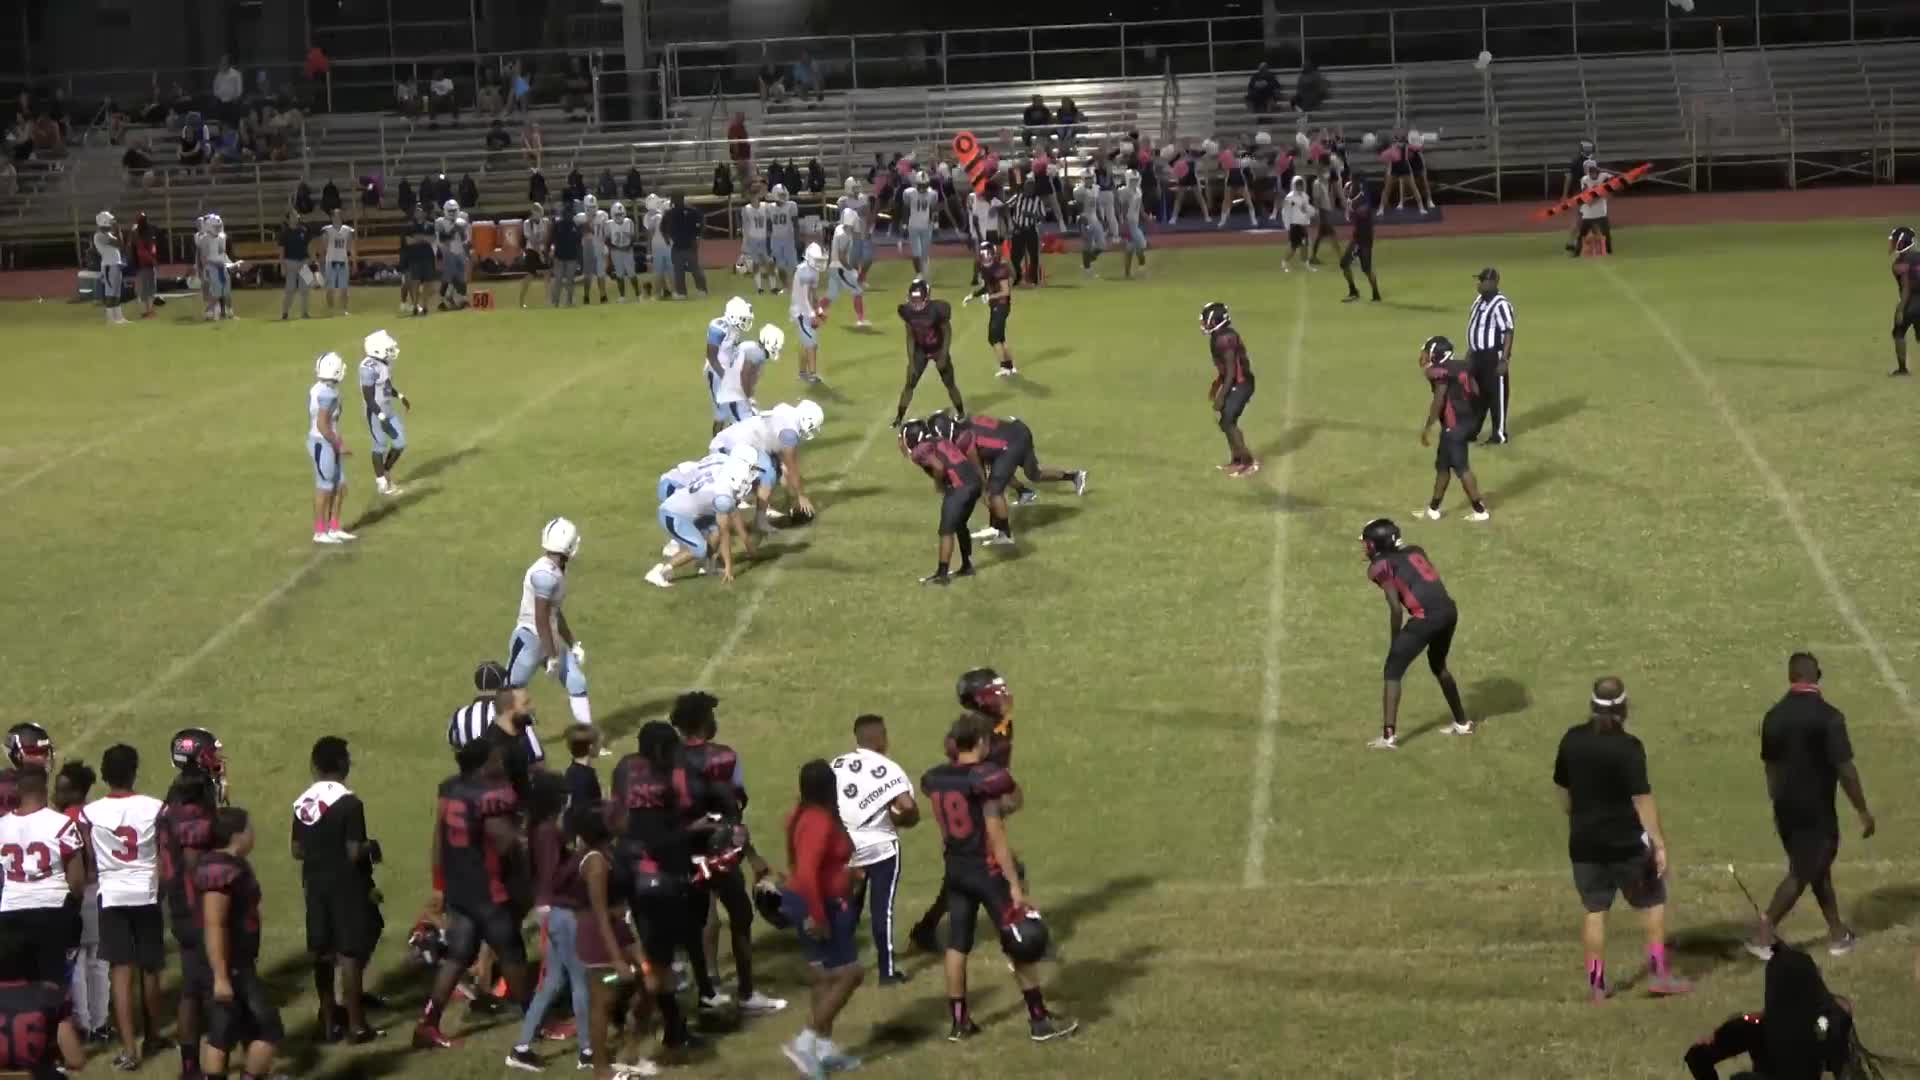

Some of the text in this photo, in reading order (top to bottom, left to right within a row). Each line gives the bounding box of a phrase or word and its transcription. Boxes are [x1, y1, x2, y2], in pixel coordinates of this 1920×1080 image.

[1, 842, 53, 882] 33
[111, 825, 138, 864] 3
[0, 1012, 47, 1063] 6
